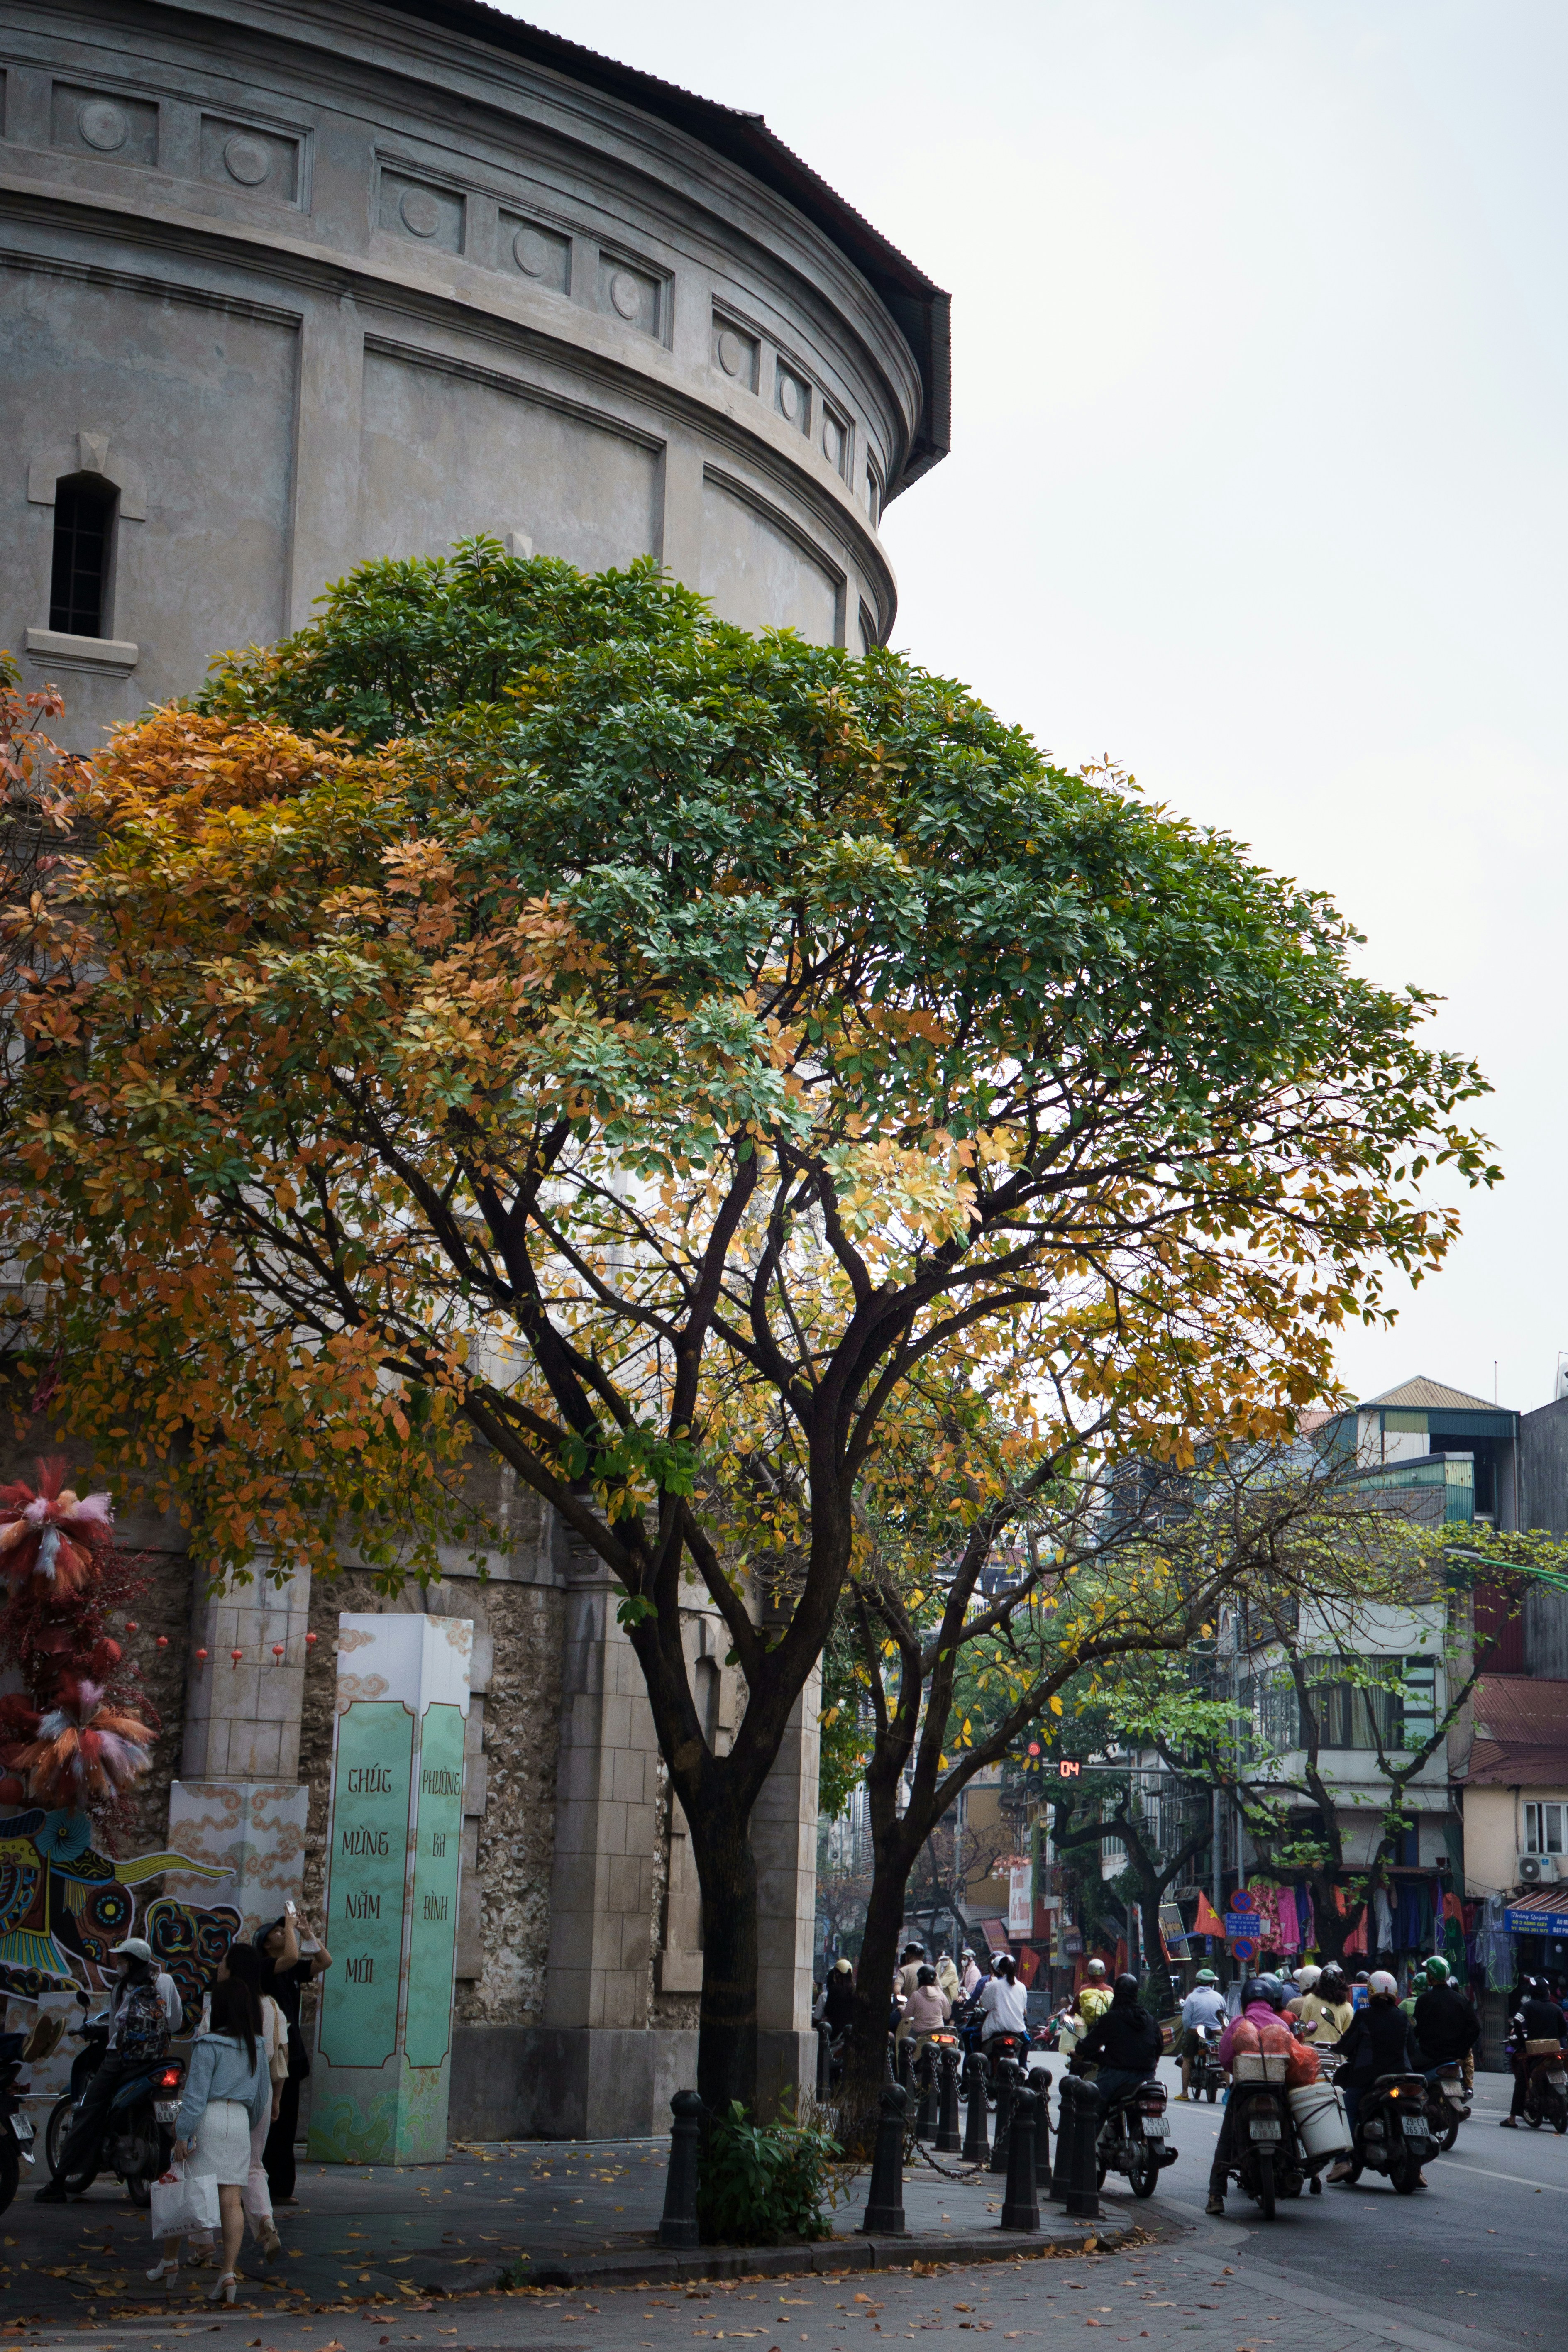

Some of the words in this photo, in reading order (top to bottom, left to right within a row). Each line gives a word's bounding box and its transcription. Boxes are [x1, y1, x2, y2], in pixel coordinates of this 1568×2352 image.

[348, 1762, 392, 1793] CHÚC
[422, 1766, 461, 1796] PHƯỜNG
[1060, 1761, 1079, 1777] 04
[341, 1824, 389, 1856] MỪNG
[432, 1833, 446, 1857] BA
[345, 1890, 381, 1920] NĂM
[423, 1890, 449, 1920] ĐÌNH
[345, 1953, 374, 1983] MỚI
[1405, 2125, 1428, 2135] 365.30
[1406, 2117, 1424, 2127] 29-C1
[162, 2223, 196, 2235] BOHEE
